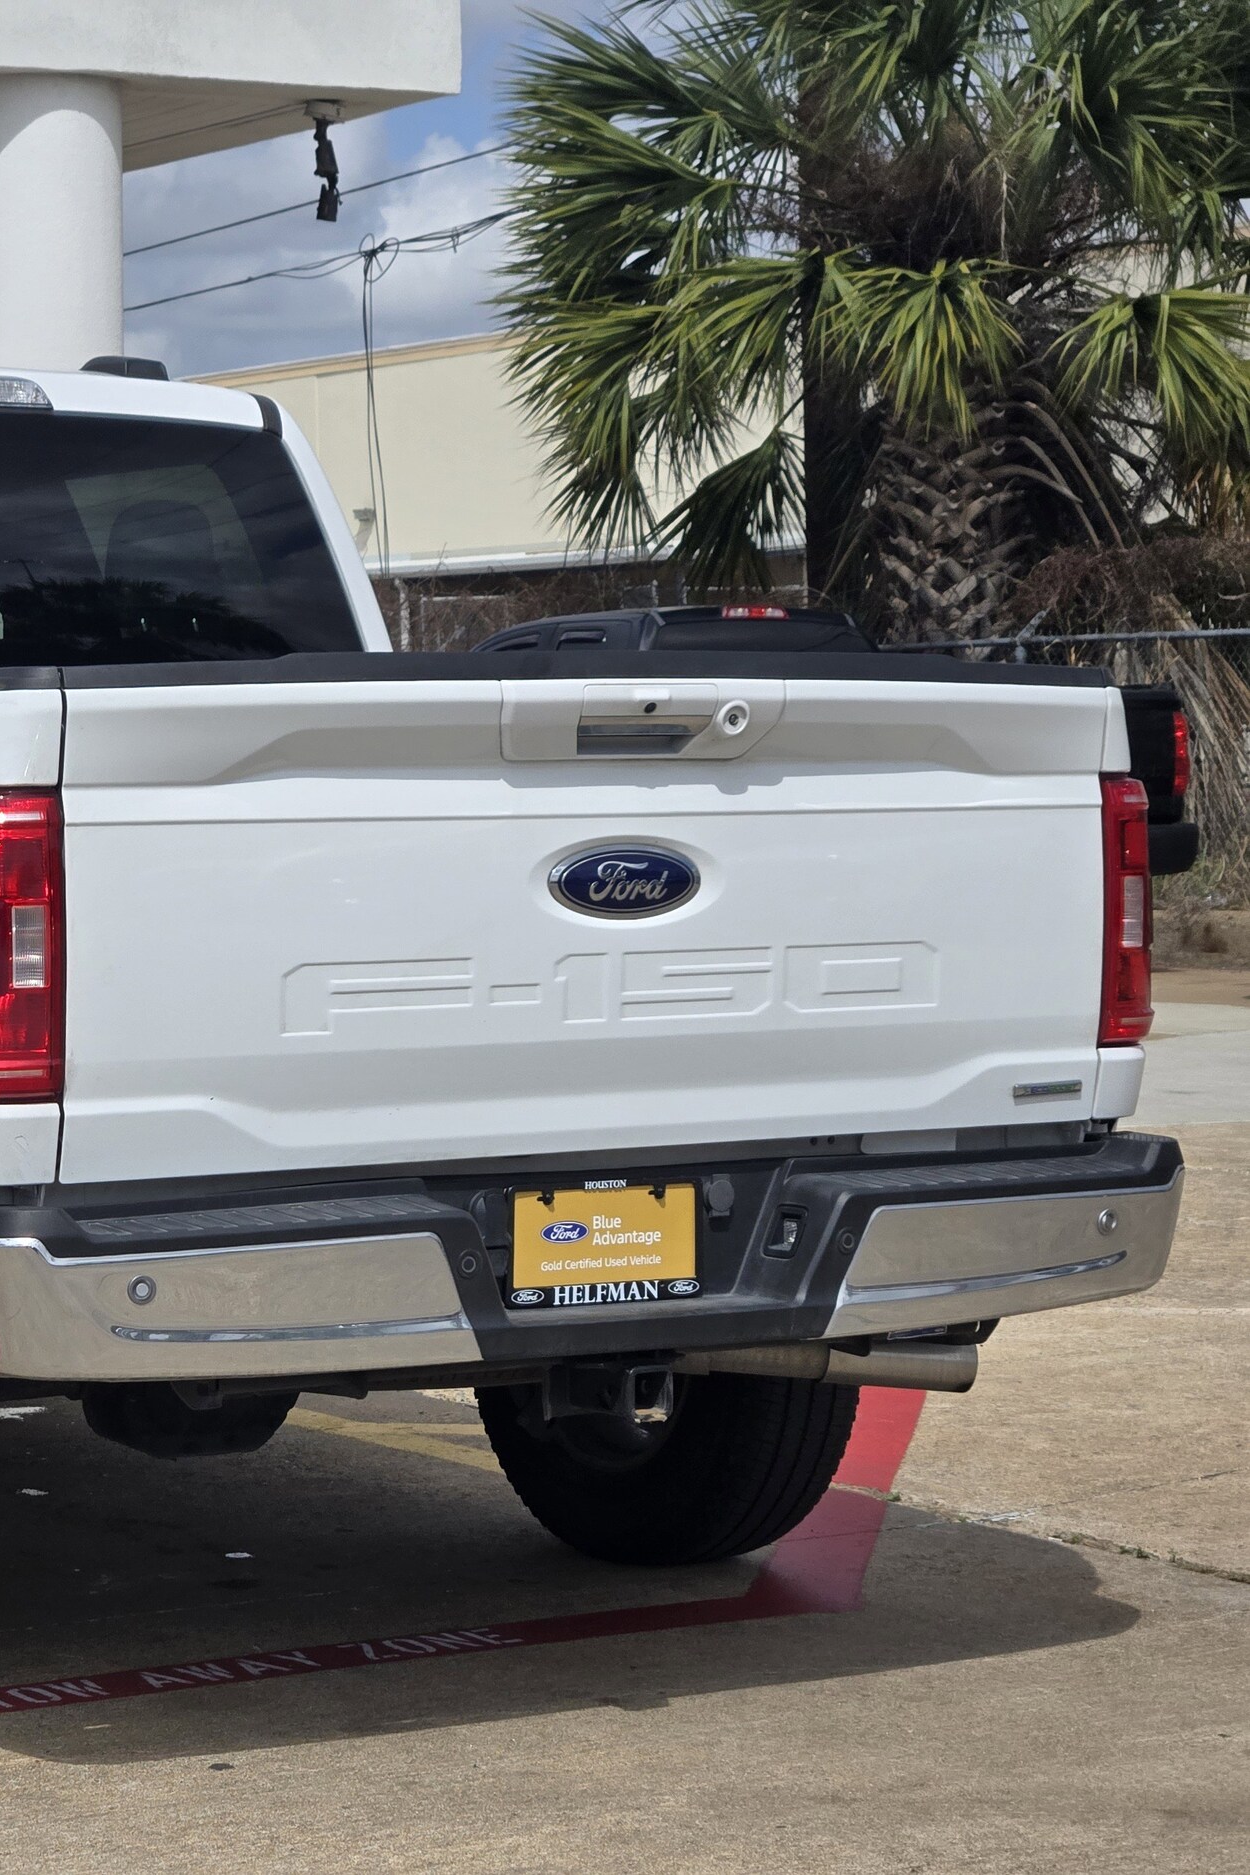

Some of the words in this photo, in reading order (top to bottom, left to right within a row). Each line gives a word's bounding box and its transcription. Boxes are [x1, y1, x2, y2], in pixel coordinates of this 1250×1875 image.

[588, 860, 669, 902] Ford
[280, 940, 941, 1036] F-150
[584, 1179, 627, 1190] HOUSTON
[550, 1223, 581, 1240] Ford
[592, 1215, 622, 1229] Blue
[592, 1230, 662, 1246] Advantage
[541, 1260, 562, 1272] Gold
[564, 1257, 603, 1270] Certified
[604, 1255, 628, 1267] Used
[630, 1253, 662, 1266] Vehicle
[553, 1280, 659, 1306] HELFMAN
[138, 1648, 322, 1689] AWAY
[337, 1627, 524, 1662] ZONE
